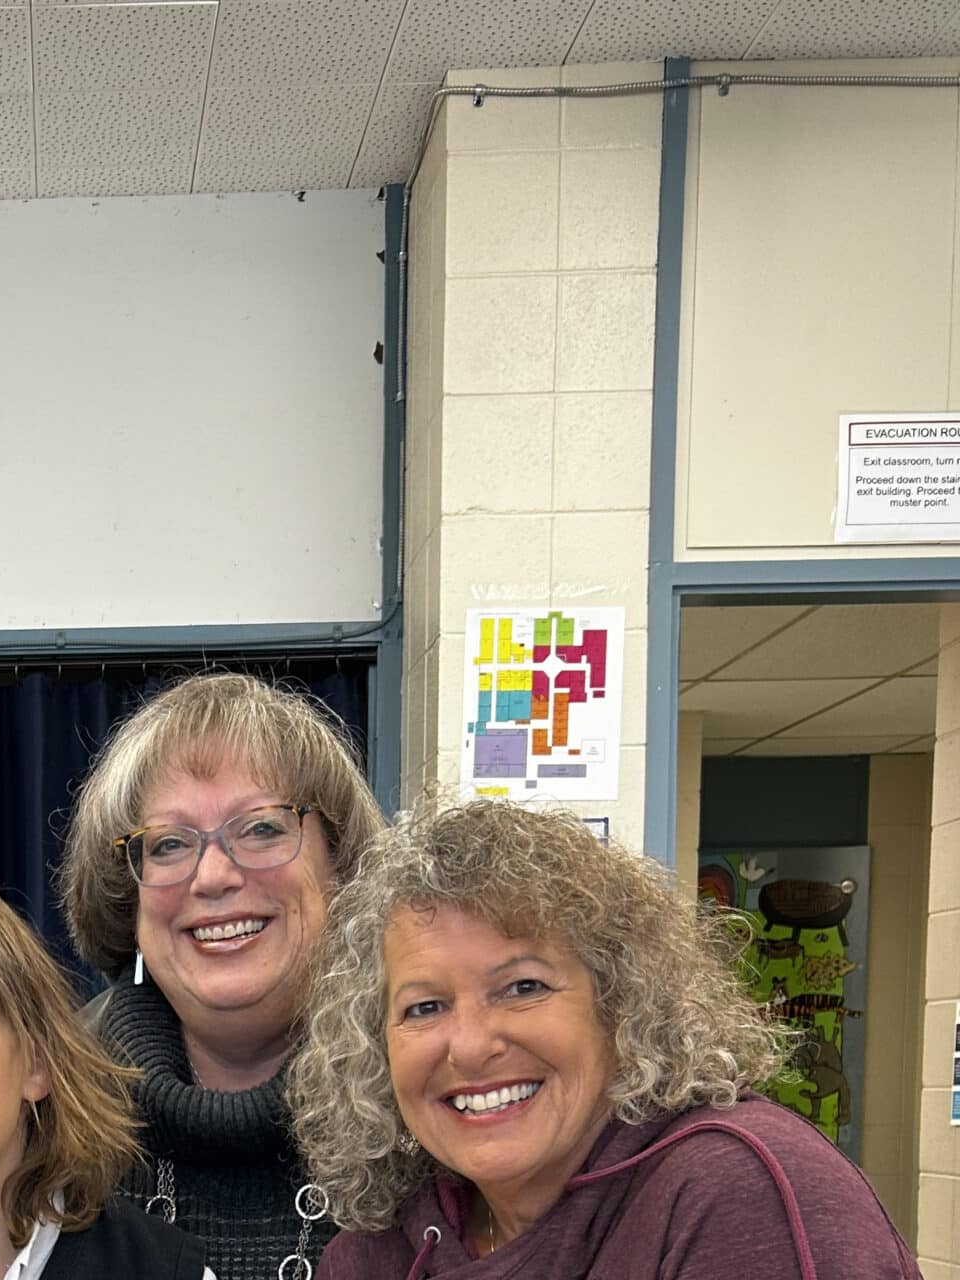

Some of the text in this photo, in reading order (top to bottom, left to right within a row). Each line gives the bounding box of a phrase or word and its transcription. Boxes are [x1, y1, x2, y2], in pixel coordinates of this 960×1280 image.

[866, 427, 938, 439] EVACUATION
[863, 457, 881, 466] Exit
[883, 456, 933, 467] classroom,
[936, 456, 954, 466] turn
[855, 475, 894, 485] Proceed
[896, 475, 921, 484] down
[924, 475, 939, 484] the
[856, 487, 874, 496] exit
[876, 486, 914, 497] building.
[916, 486, 955, 496] Proceed
[889, 497, 949, 508] muster point.
